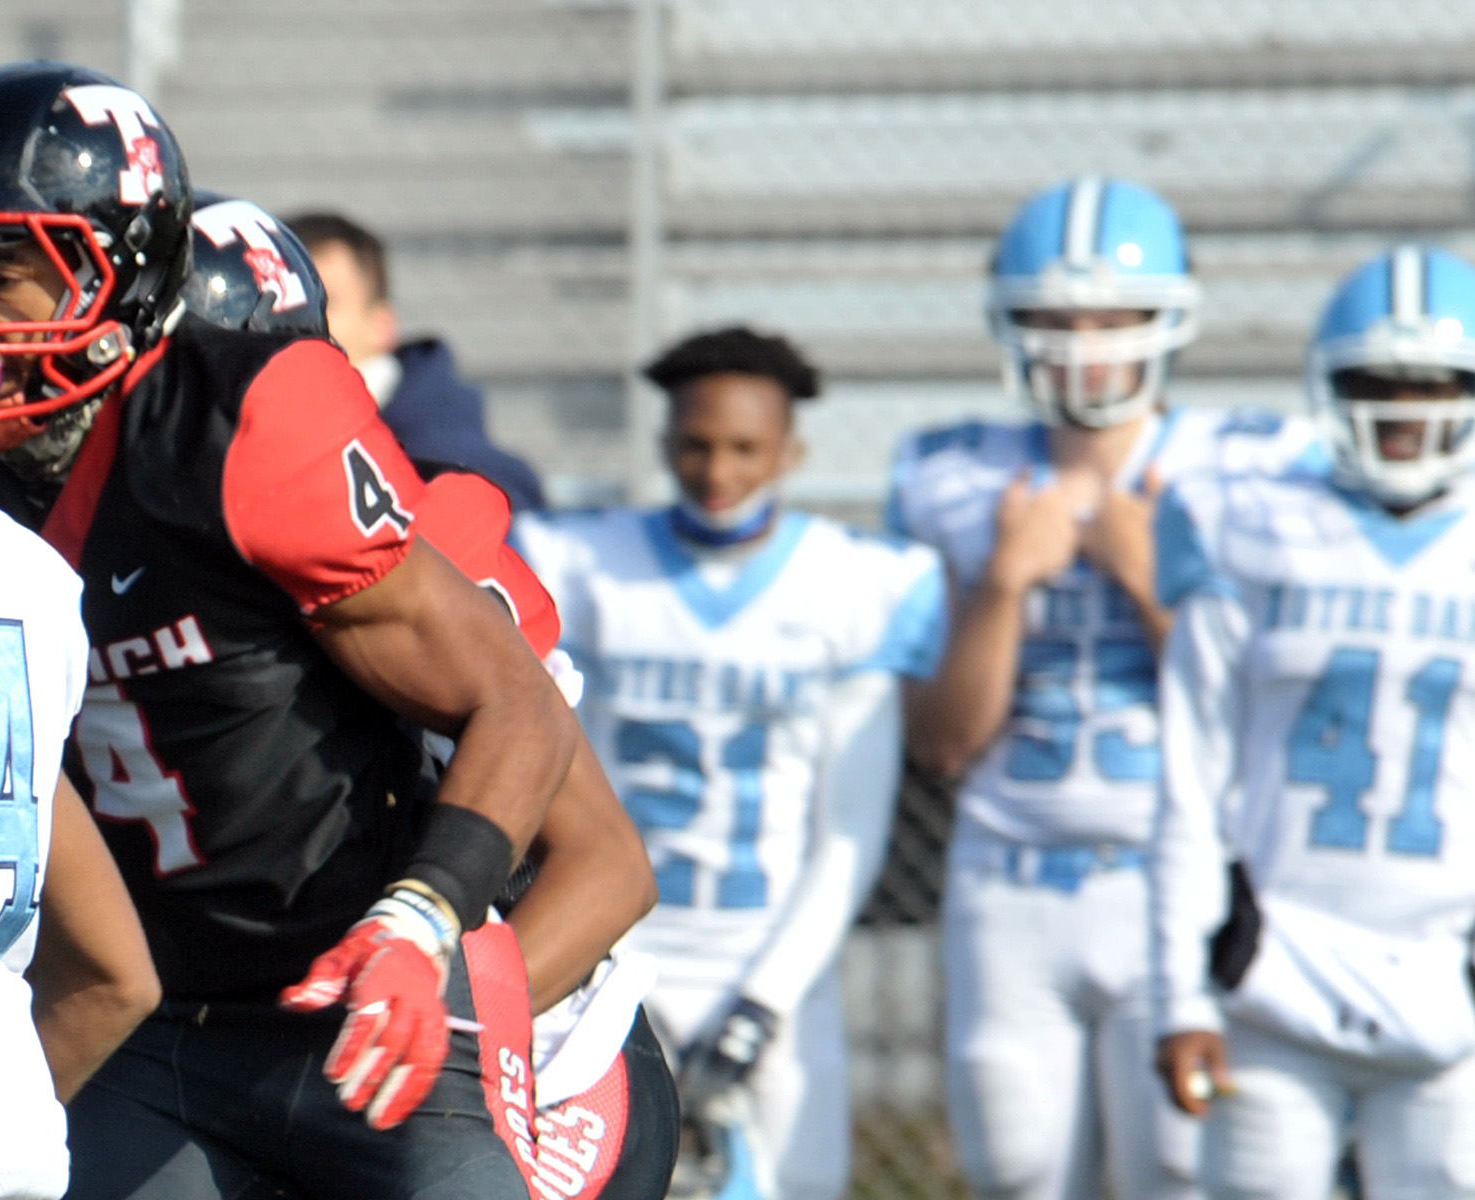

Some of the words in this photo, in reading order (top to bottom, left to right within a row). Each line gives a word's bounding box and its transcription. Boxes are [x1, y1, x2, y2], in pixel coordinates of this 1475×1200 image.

[343, 438, 416, 540] 4
[76, 683, 211, 880] 4
[1285, 645, 1461, 857] 41
